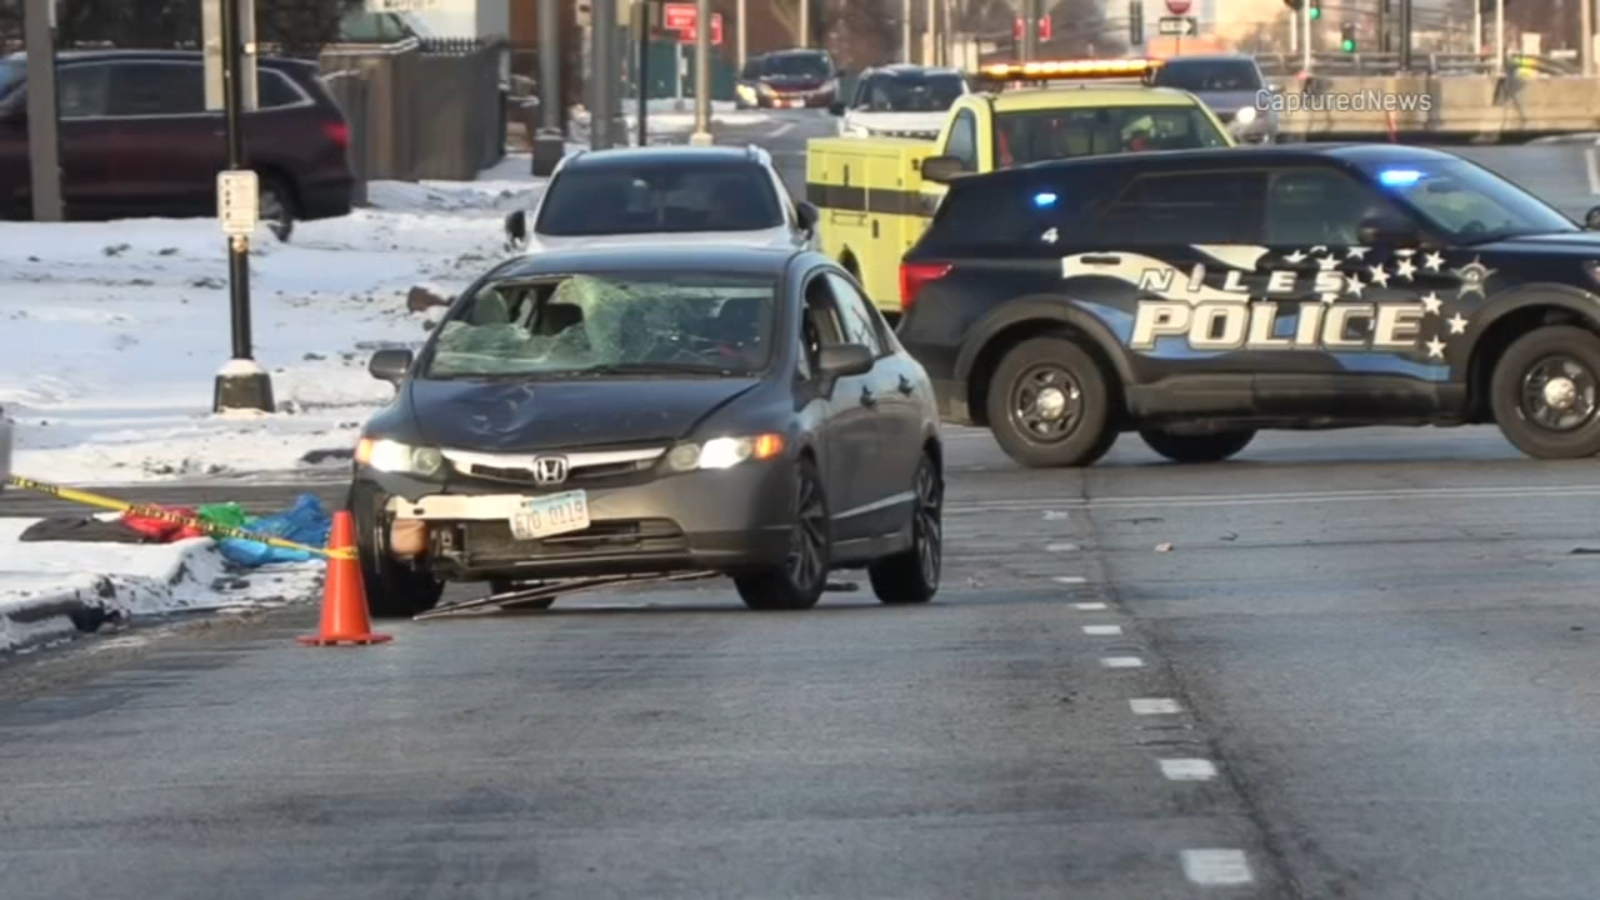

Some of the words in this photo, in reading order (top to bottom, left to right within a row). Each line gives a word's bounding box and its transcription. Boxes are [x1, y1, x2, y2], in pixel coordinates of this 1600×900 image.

[1041, 227, 1058, 244] 4
[1138, 263, 1347, 292] NILES
[1130, 300, 1426, 350] POLICE
